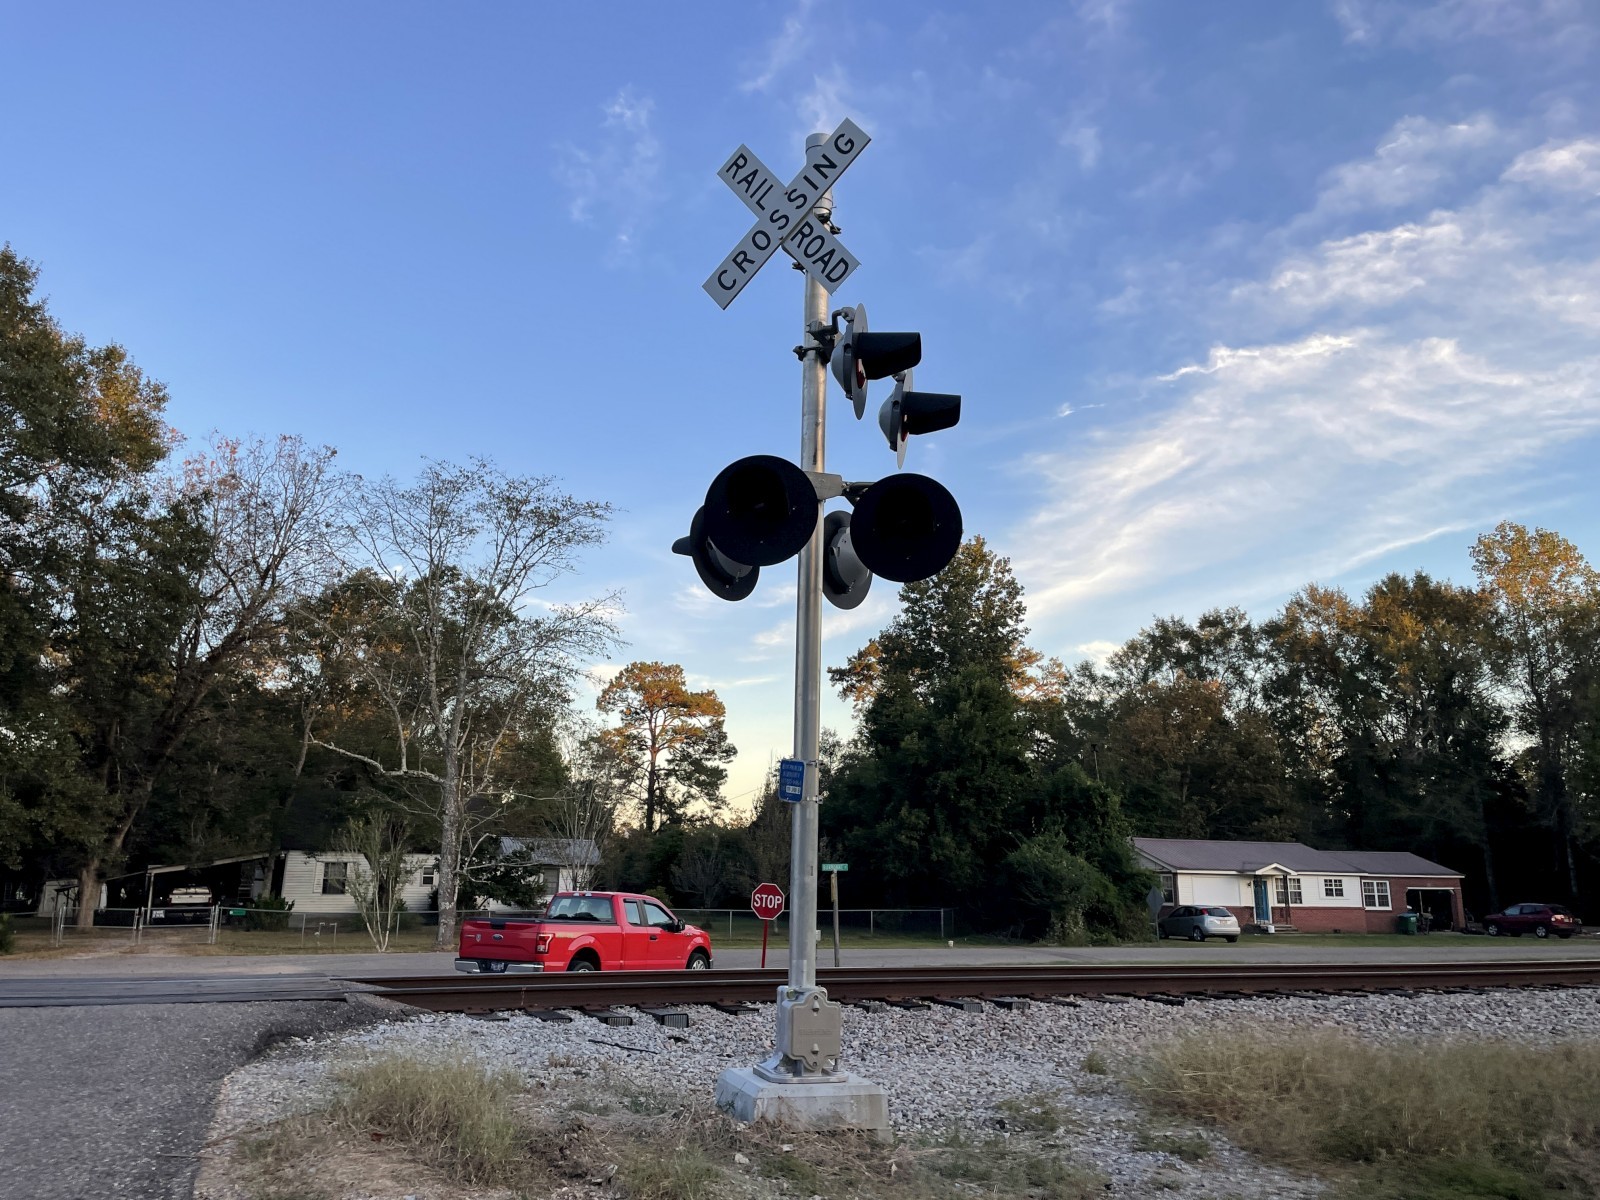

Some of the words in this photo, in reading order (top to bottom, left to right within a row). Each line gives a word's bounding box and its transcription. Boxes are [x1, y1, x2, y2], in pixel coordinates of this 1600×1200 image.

[717, 133, 855, 291] CROSSING
[725, 152, 774, 211] RAIL
[790, 220, 849, 283] ROAD
[753, 893, 782, 909] STOP
